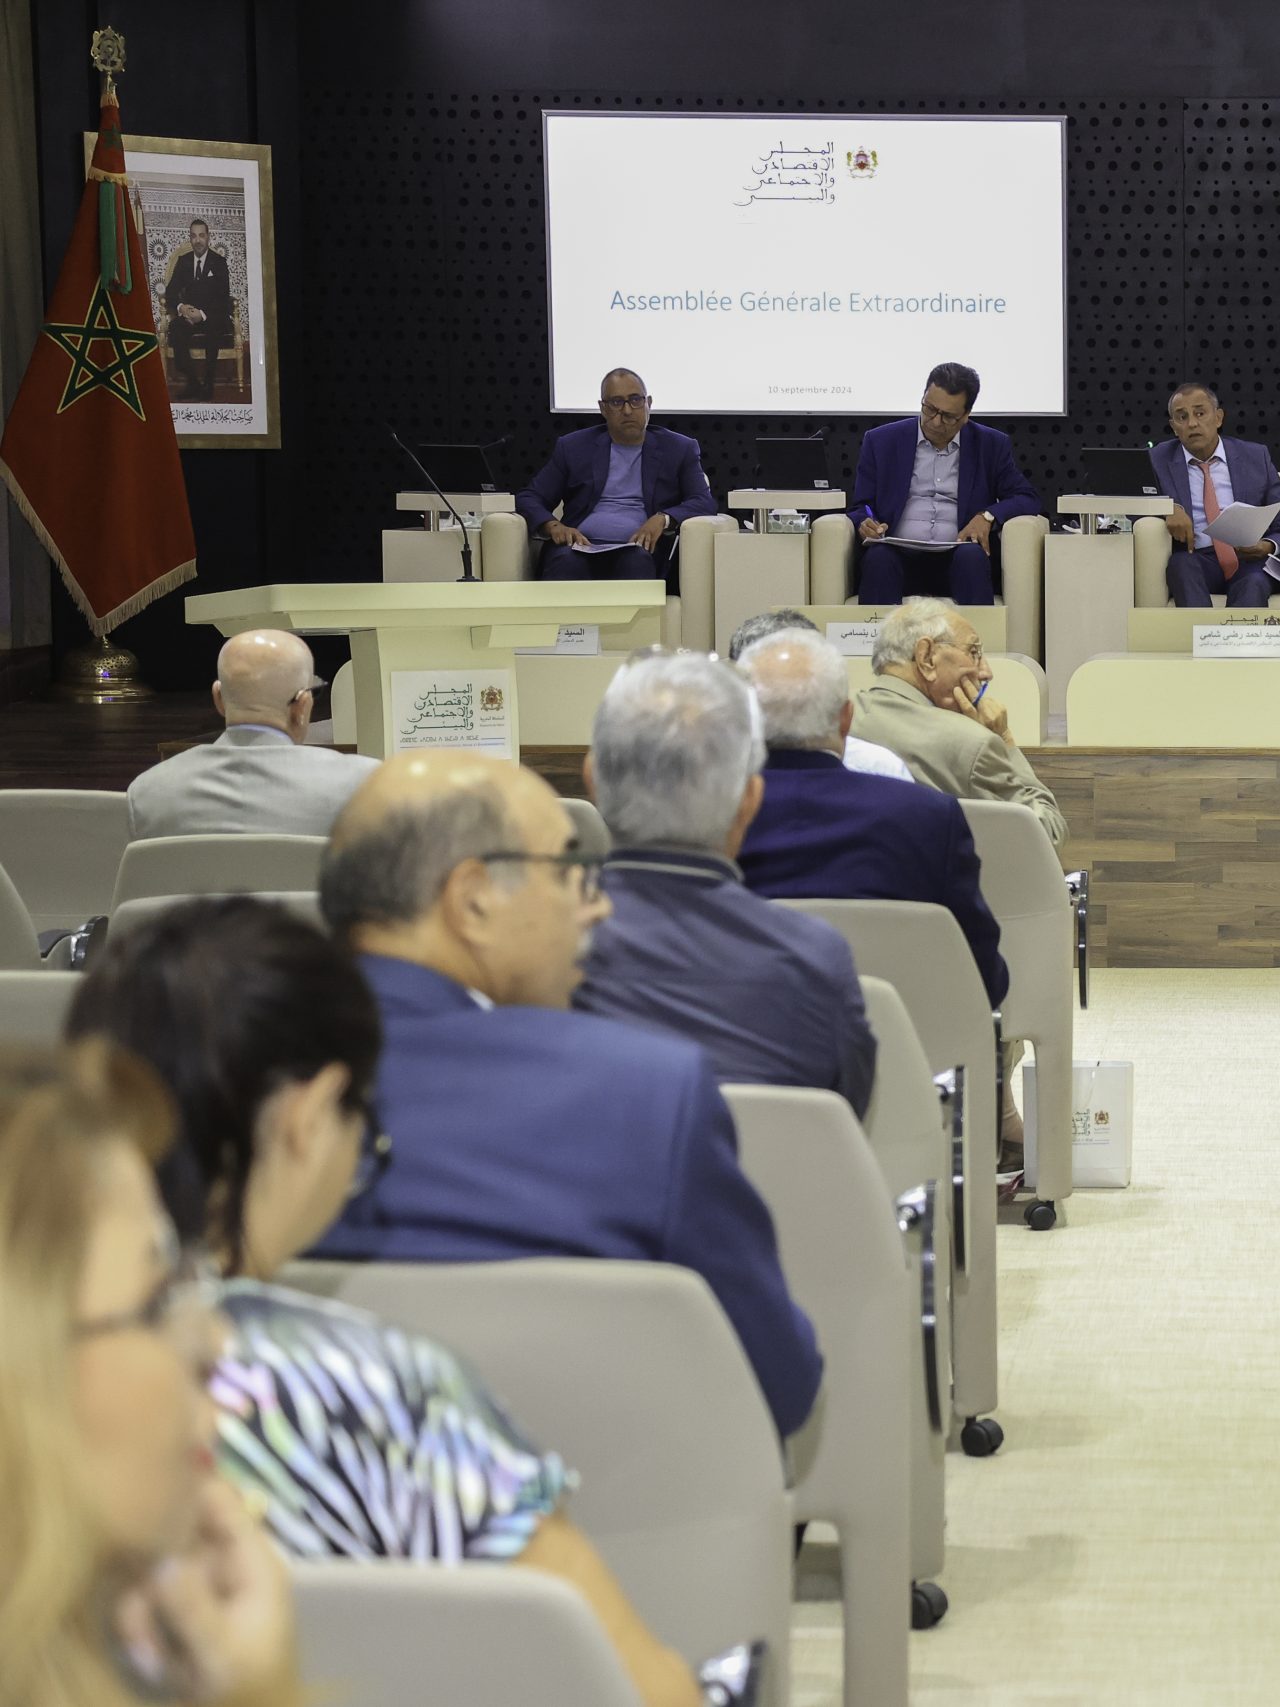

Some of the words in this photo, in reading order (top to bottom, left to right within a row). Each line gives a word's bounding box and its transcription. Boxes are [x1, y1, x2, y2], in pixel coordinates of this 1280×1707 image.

[759, 140, 835, 162] المجلس
[610, 289, 733, 312] Assemblée
[740, 290, 841, 313] Générale
[849, 291, 1007, 314] Extraordinaire
[768, 386, 778, 394] 10
[781, 385, 828, 395] septembre
[831, 386, 852, 394] 2024
[419, 683, 472, 701] المجلس
[414, 695, 473, 711] الاقتصادي
[406, 706, 474, 723] والاجتماعي
